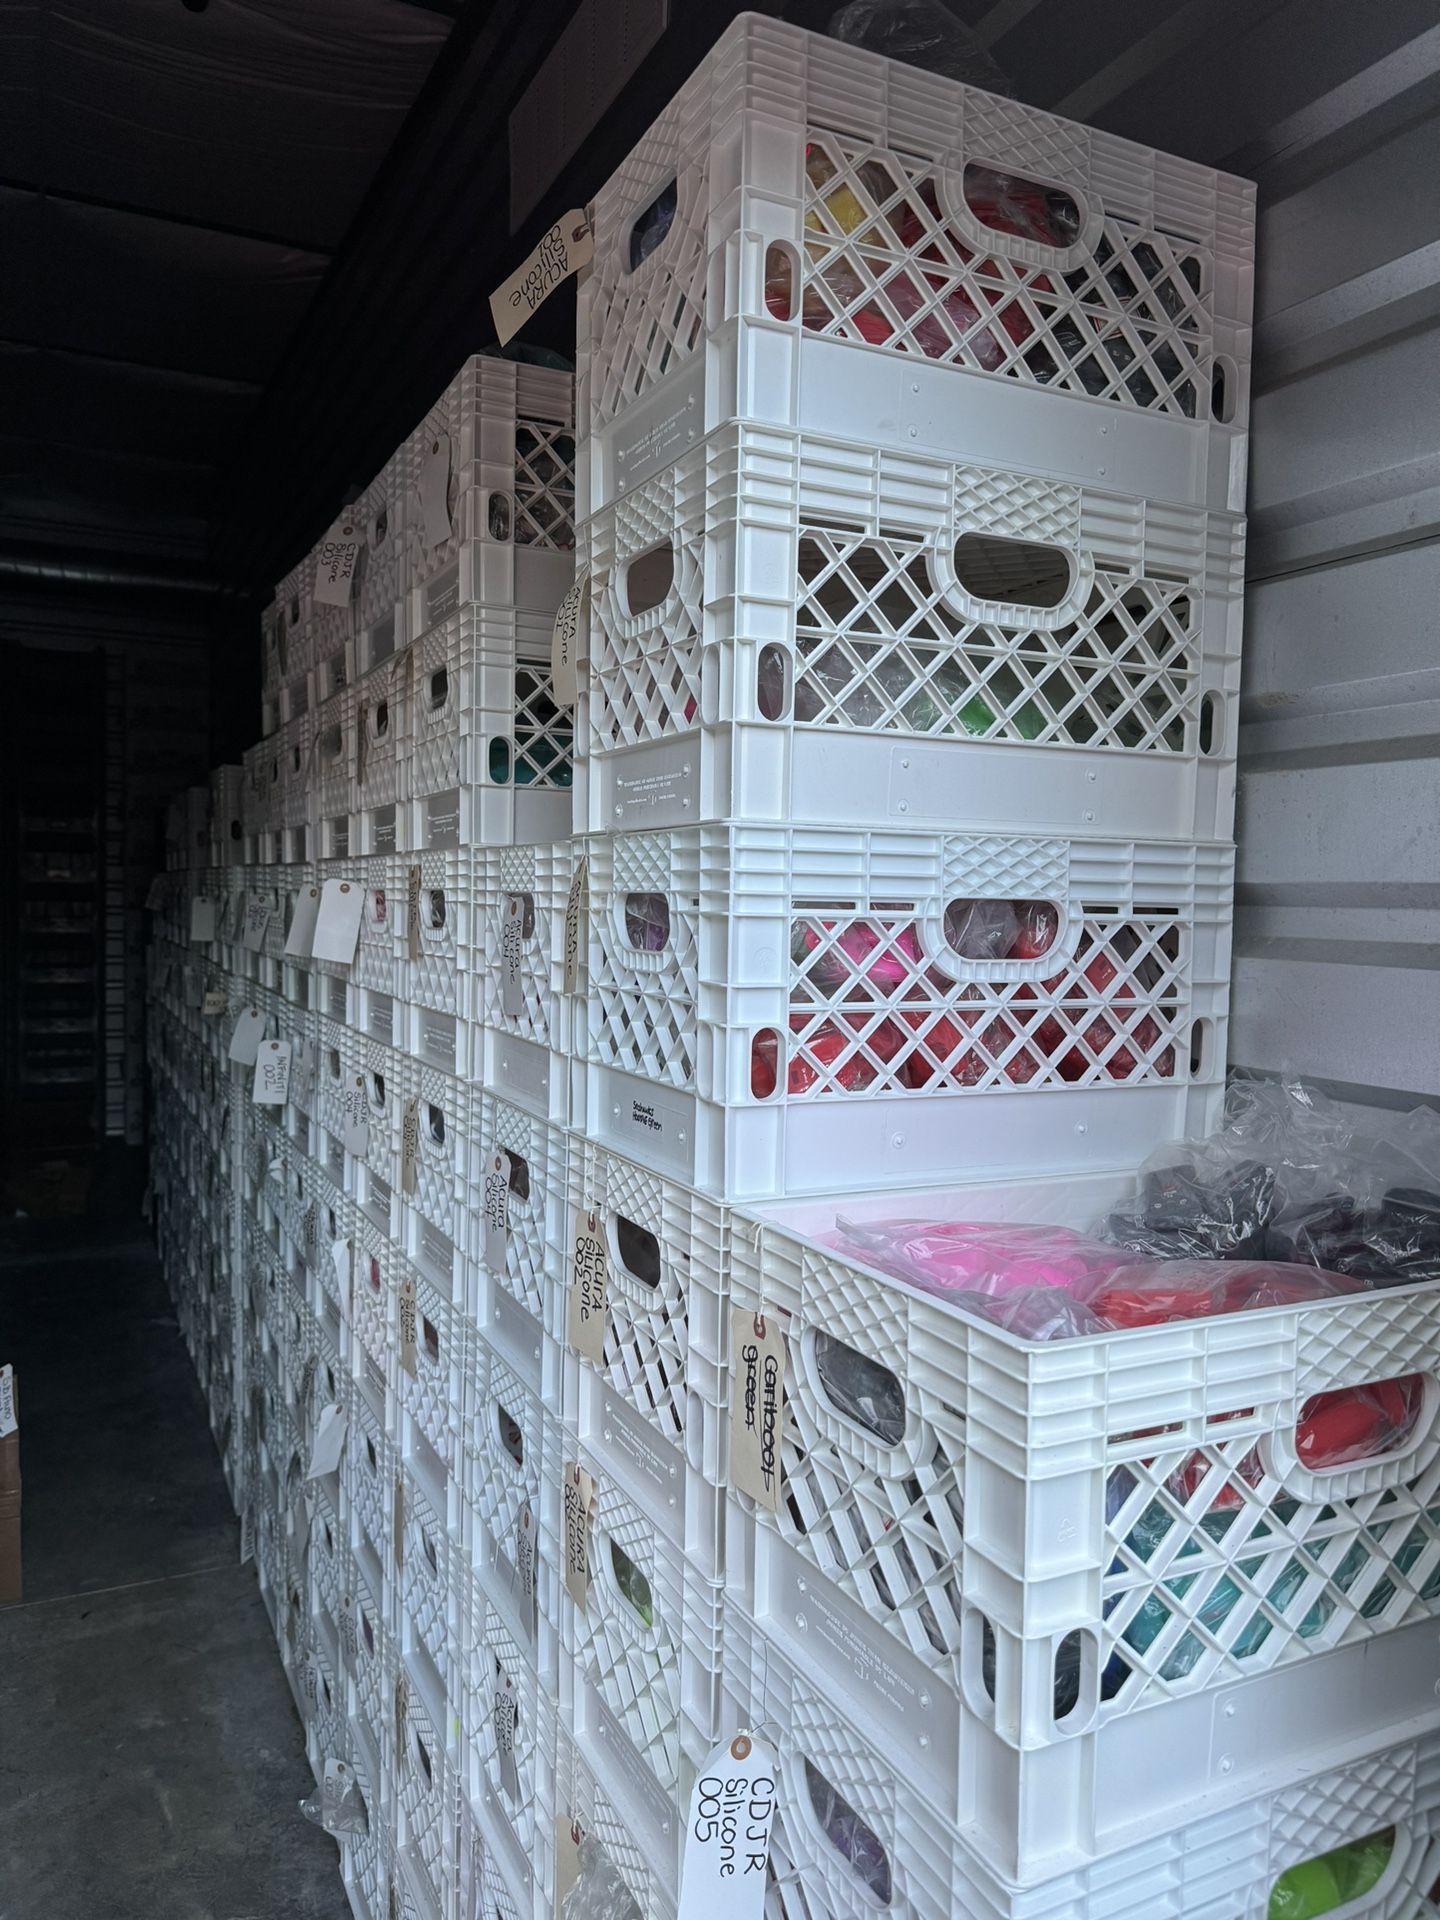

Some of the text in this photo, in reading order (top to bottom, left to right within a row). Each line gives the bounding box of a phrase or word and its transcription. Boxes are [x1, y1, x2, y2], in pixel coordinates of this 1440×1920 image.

[527, 251, 568, 310] ACURA
[498, 1175, 507, 1228] Acura
[574, 1237, 586, 1285] 002
[695, 1777, 724, 1842] 005
[720, 1778, 749, 1878] Silicone
[744, 1777, 775, 1875] CDJR
